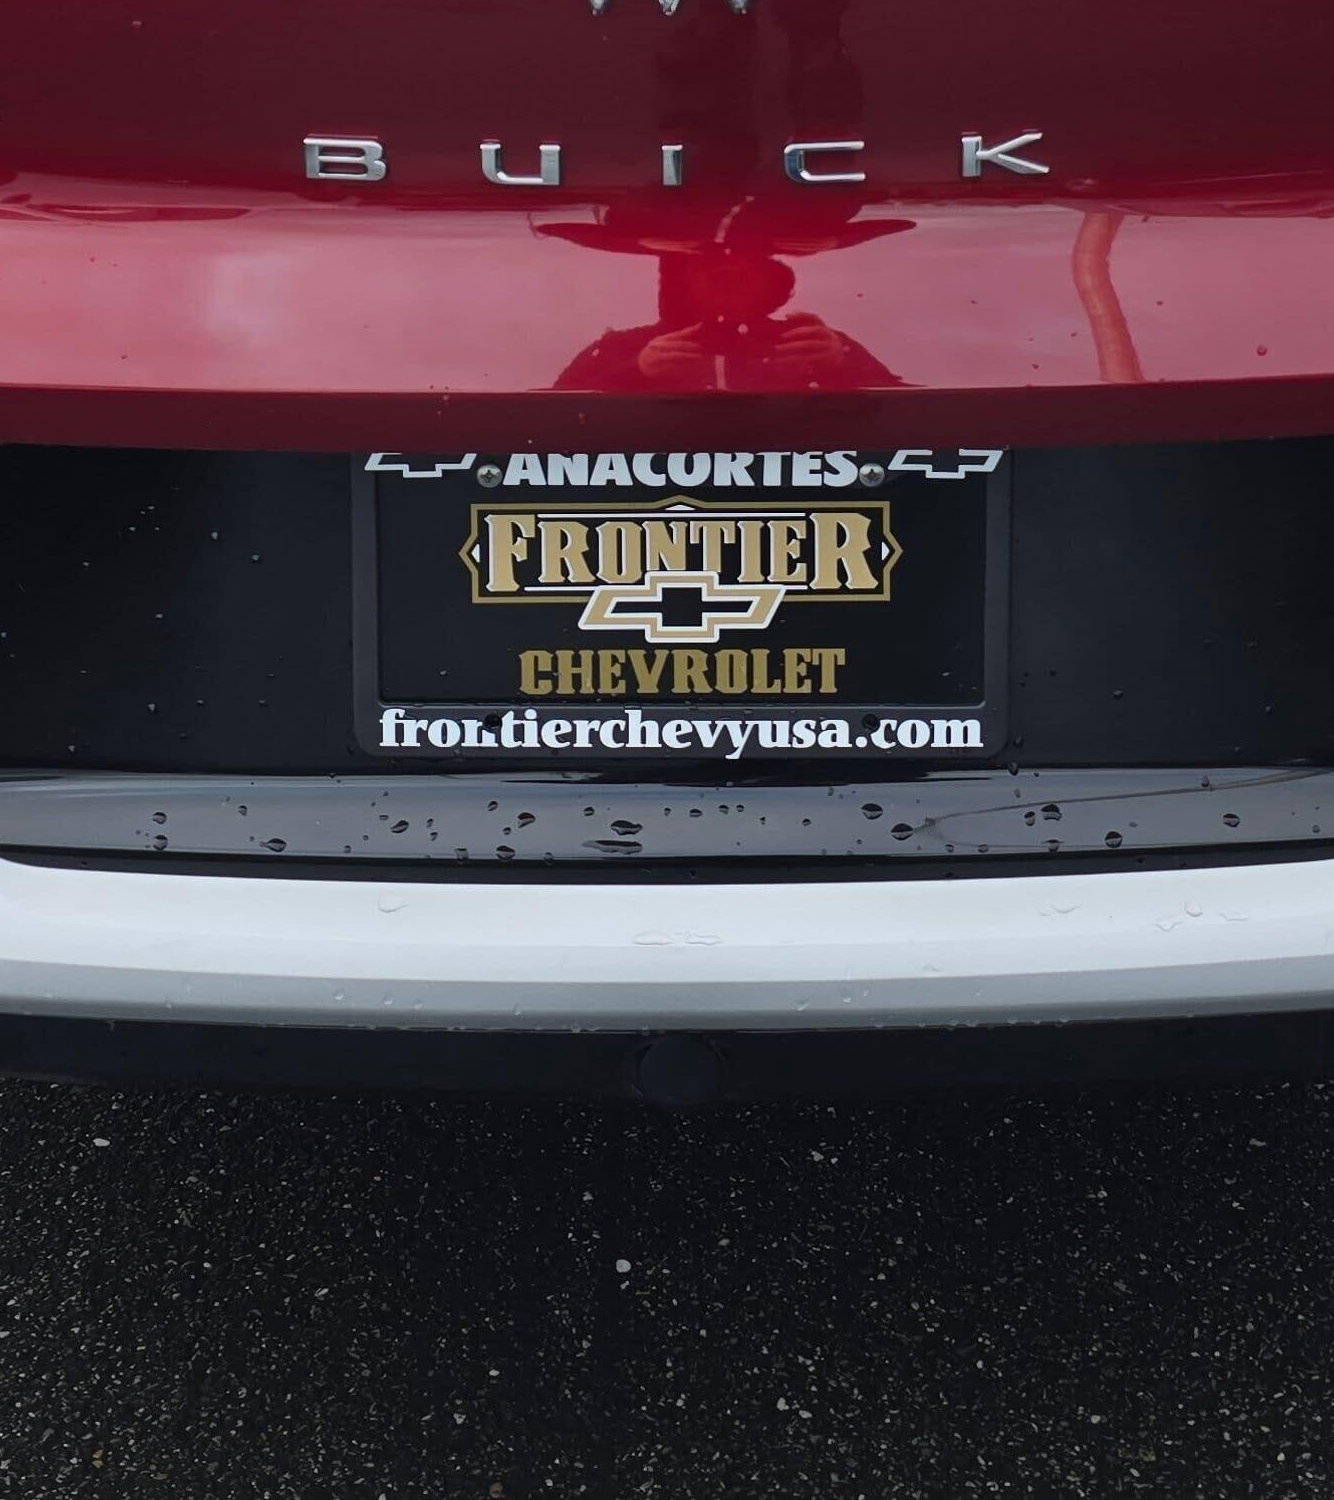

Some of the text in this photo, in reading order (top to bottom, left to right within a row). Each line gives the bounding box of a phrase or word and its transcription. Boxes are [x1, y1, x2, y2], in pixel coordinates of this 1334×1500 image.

[303, 132, 1050, 185] BUICK
[502, 451, 859, 487] ANACORTES
[484, 511, 880, 592] FRONTIER
[518, 648, 846, 695] CHEVROLET
[378, 707, 984, 760] frontierchevyusa.com
